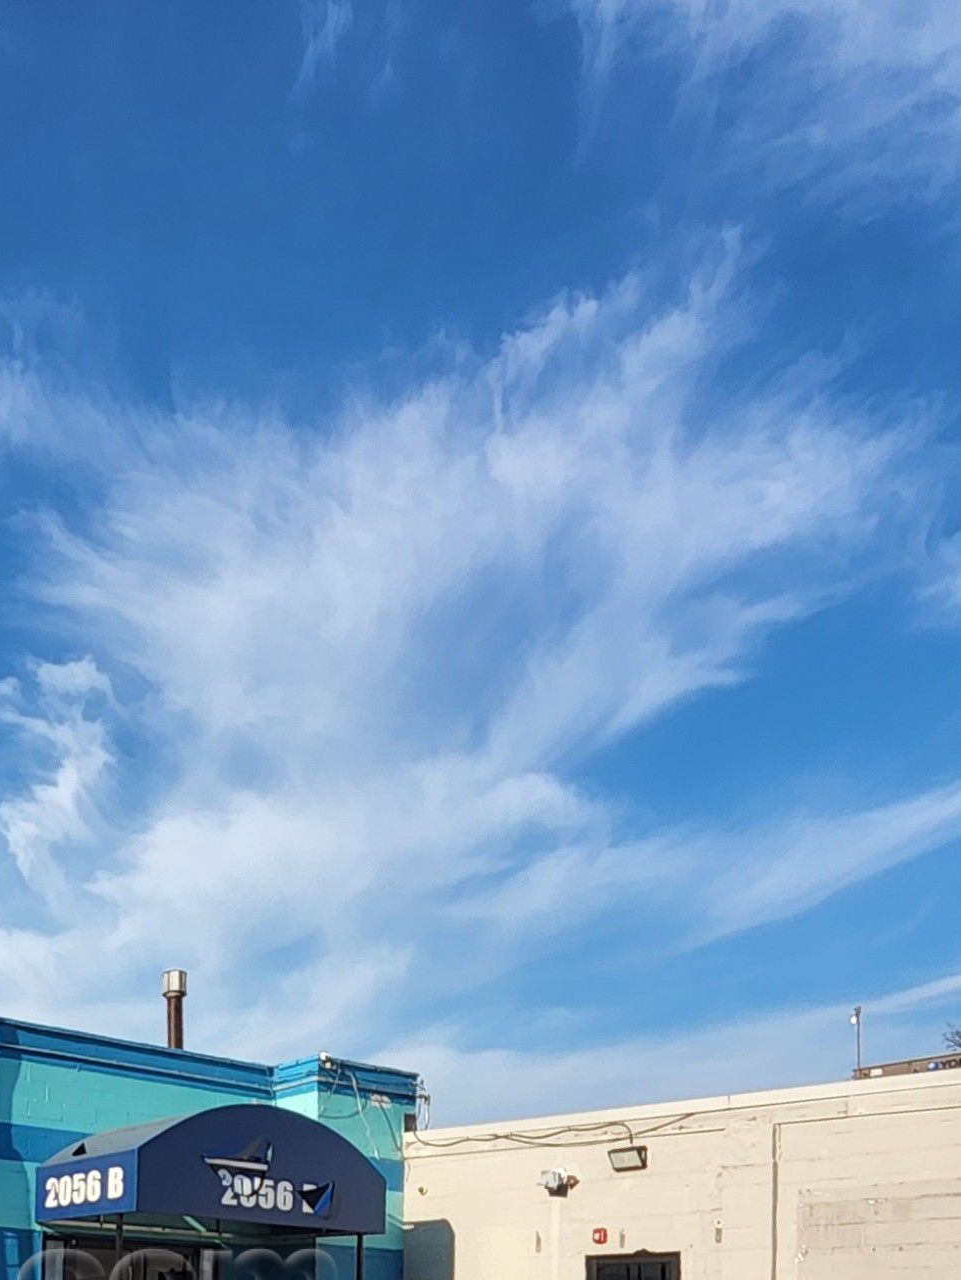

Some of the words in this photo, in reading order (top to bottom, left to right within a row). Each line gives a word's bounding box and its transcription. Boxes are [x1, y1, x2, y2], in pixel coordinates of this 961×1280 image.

[940, 1059, 961, 1069] YO
[44, 1169, 102, 1208] 2056
[107, 1166, 124, 1199] B
[218, 1168, 294, 1211] 2056
